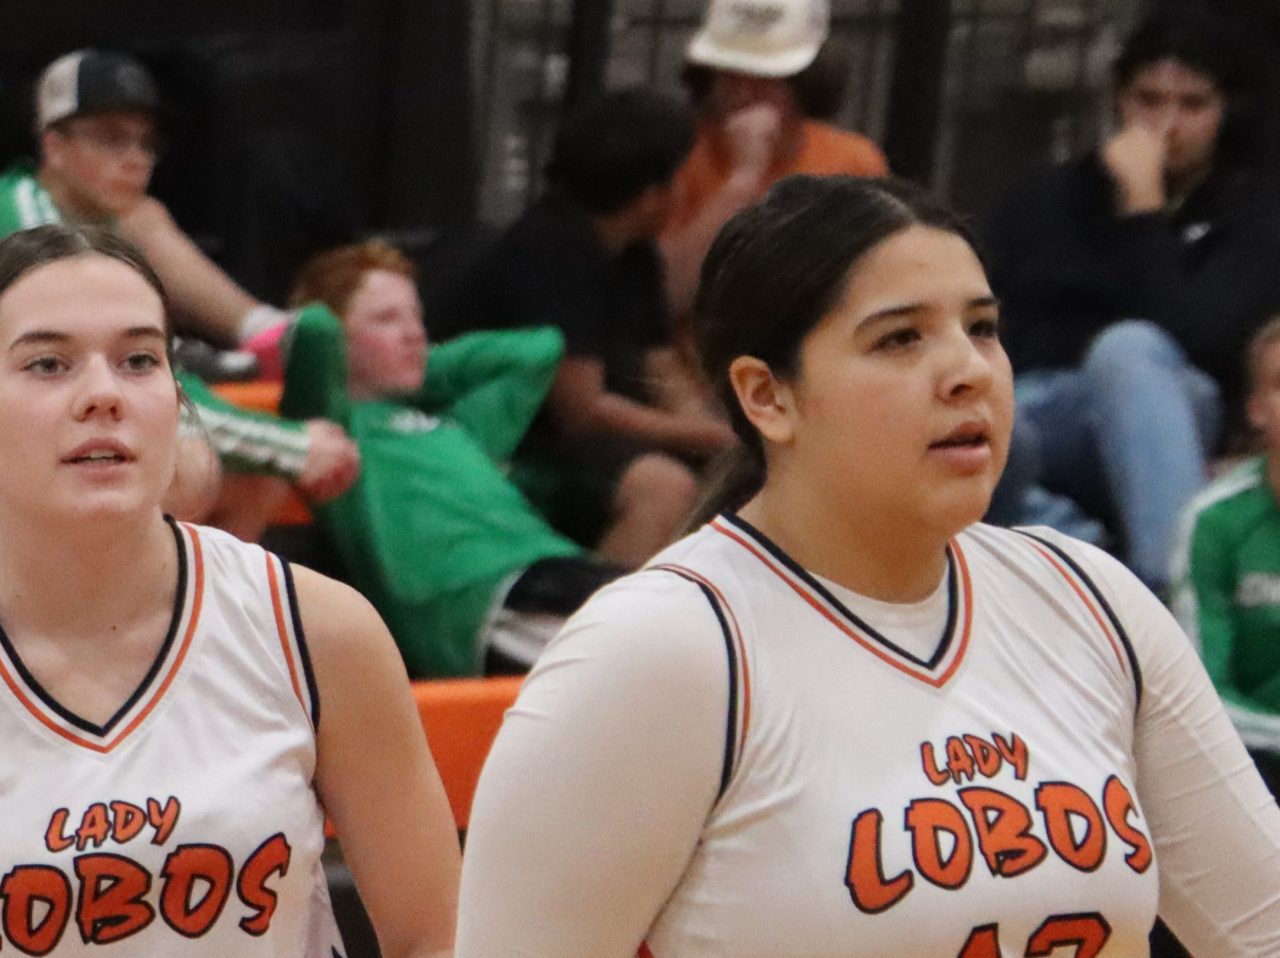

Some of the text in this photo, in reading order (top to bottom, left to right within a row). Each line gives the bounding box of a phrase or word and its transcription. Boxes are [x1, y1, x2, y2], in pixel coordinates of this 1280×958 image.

[921, 732, 1028, 786] LADY
[45, 796, 180, 853] LADY
[845, 775, 1153, 914] LOBOS
